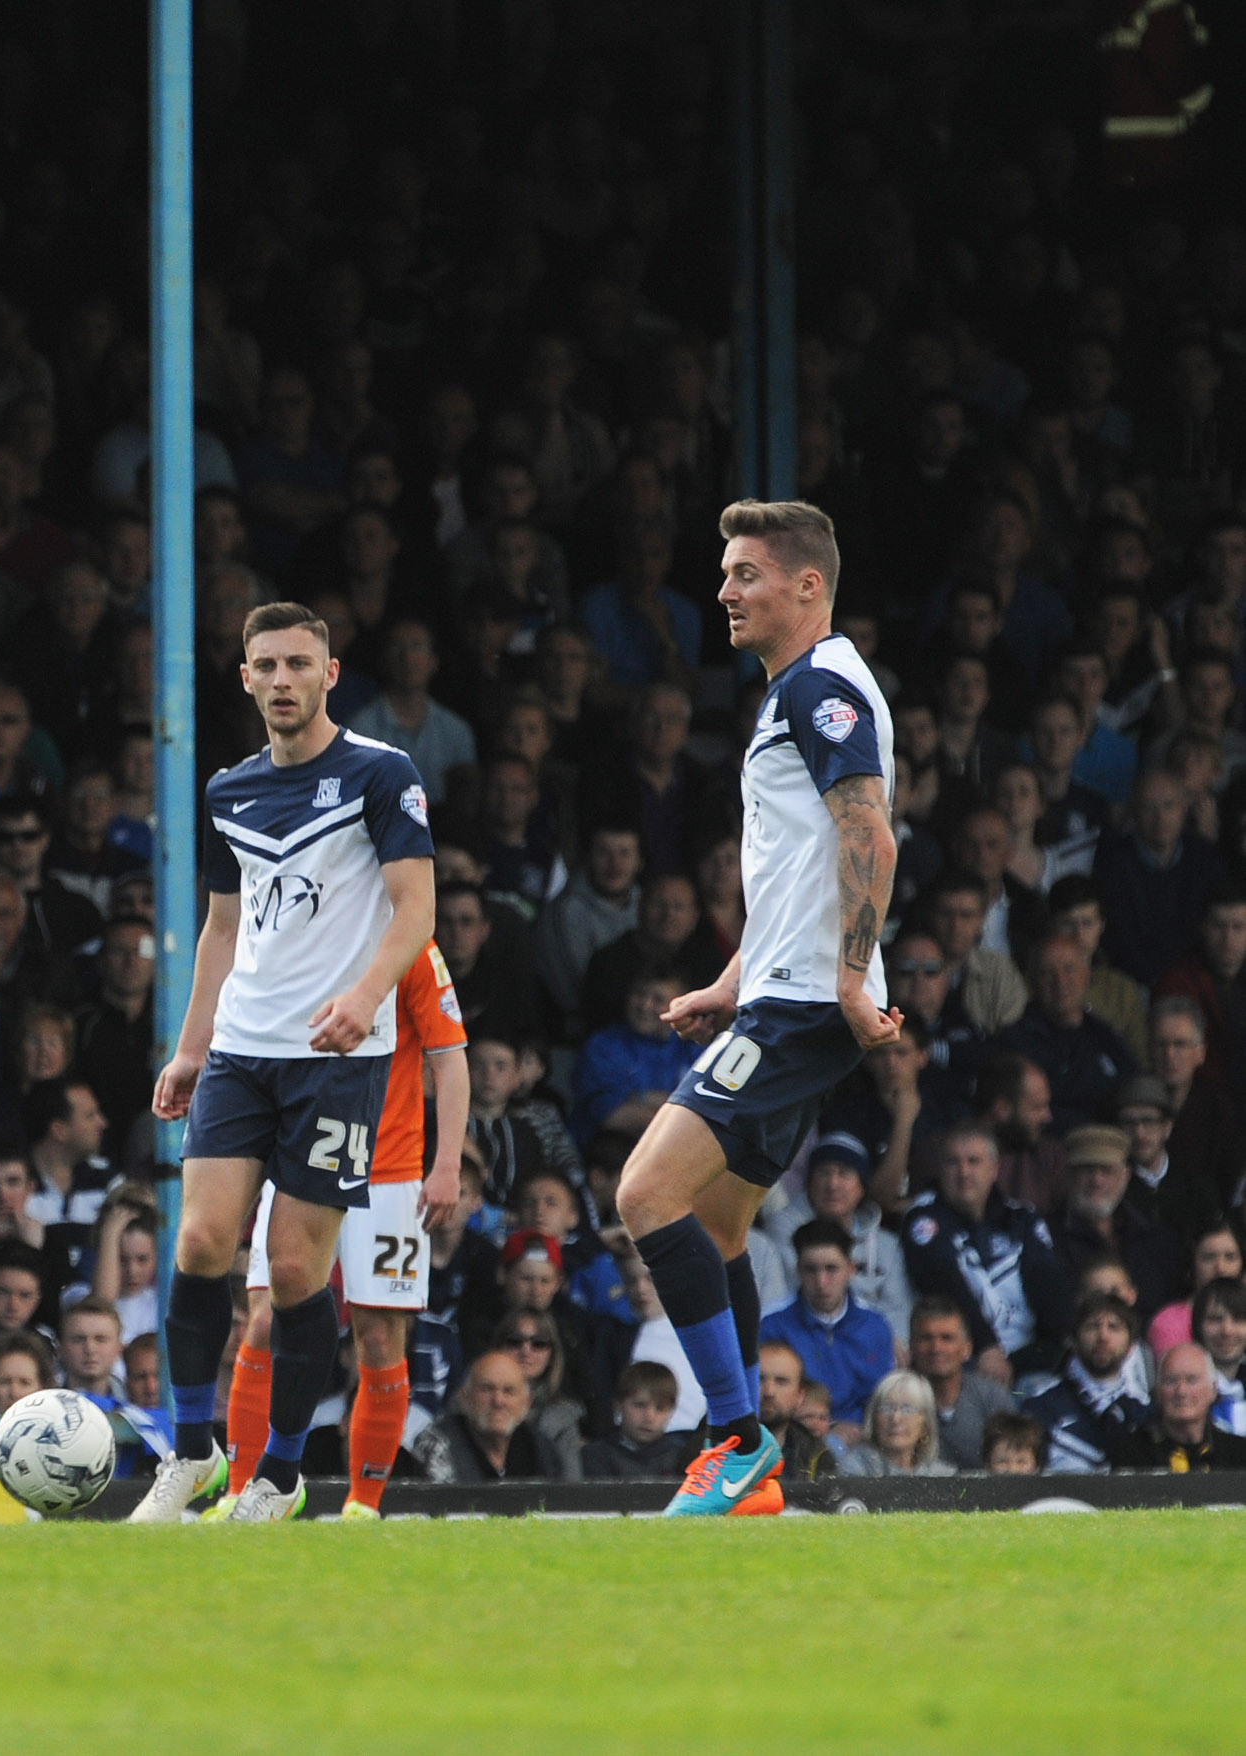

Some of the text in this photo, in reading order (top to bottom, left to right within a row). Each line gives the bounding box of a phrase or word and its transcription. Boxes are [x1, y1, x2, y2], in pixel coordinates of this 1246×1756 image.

[832, 711, 854, 723] BET
[693, 1030, 762, 1092] 10
[307, 1116, 369, 1176] 24
[373, 1234, 419, 1279] 22
